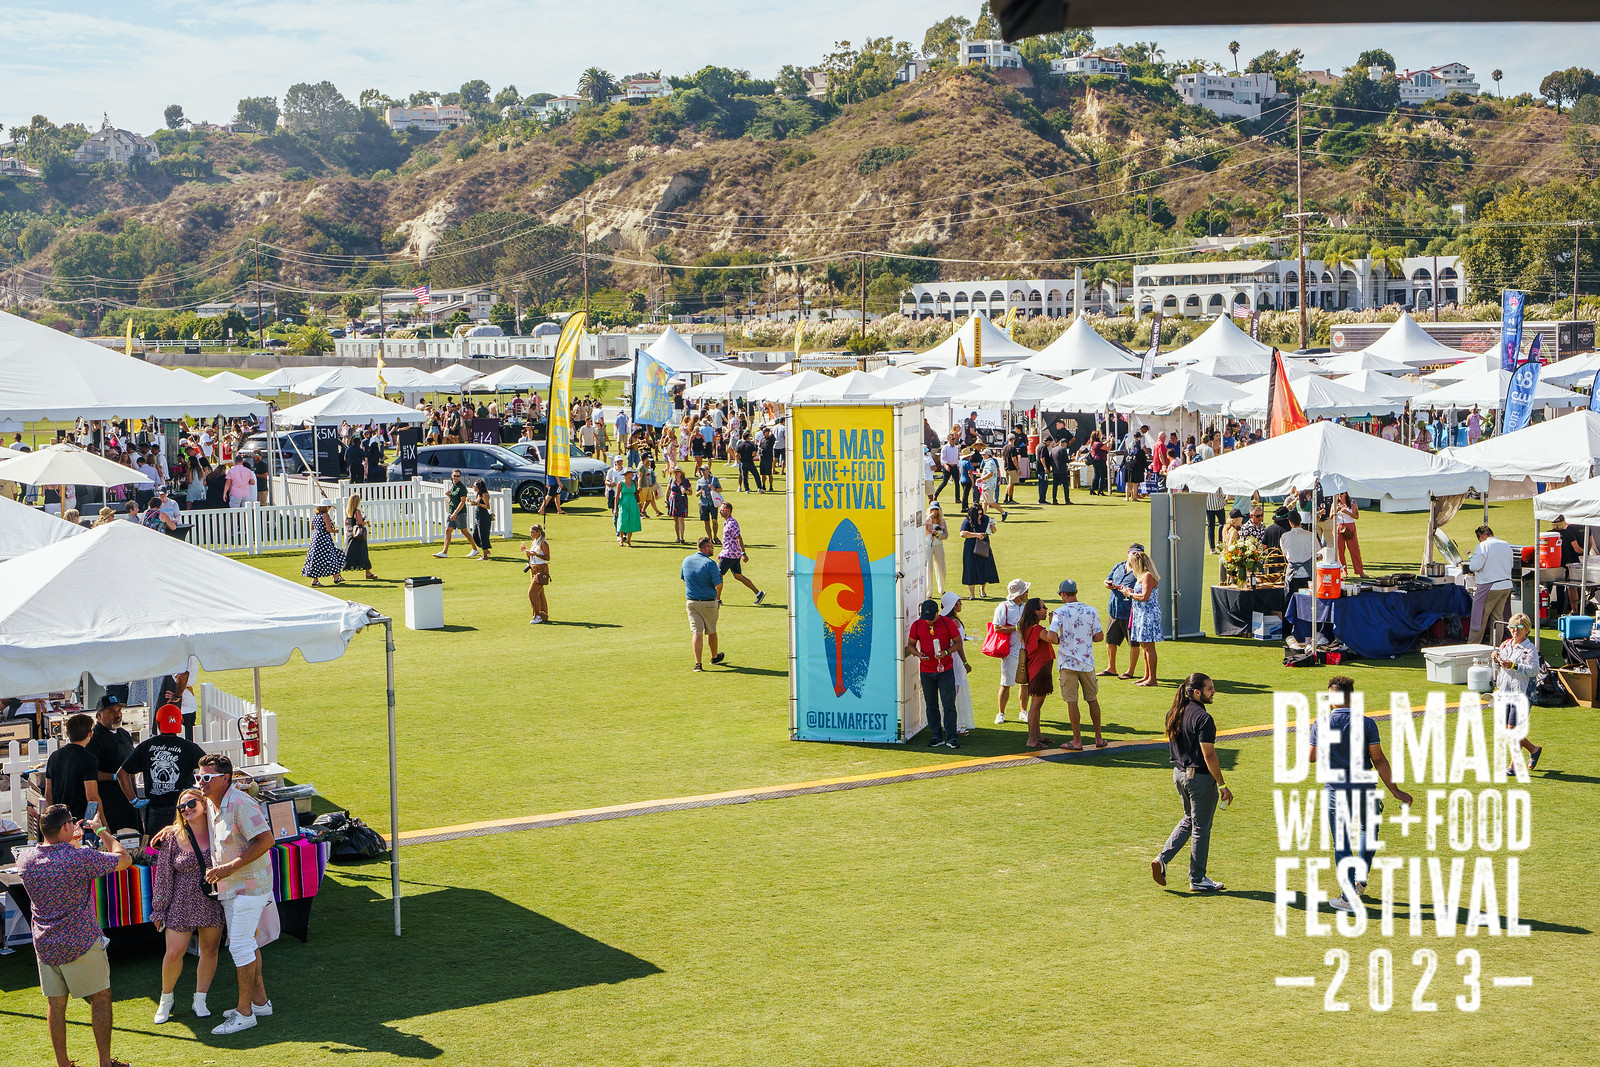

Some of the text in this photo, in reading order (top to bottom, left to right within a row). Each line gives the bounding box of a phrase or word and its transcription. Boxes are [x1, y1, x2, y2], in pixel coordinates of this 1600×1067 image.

[406, 444, 416, 460] iX
[802, 429, 837, 460] DEL
[839, 429, 885, 460] MAR
[802, 460, 886, 482] WINE+FOOD
[803, 482, 886, 510] FESTIVAL
[806, 710, 888, 731] @DELMARFEST
